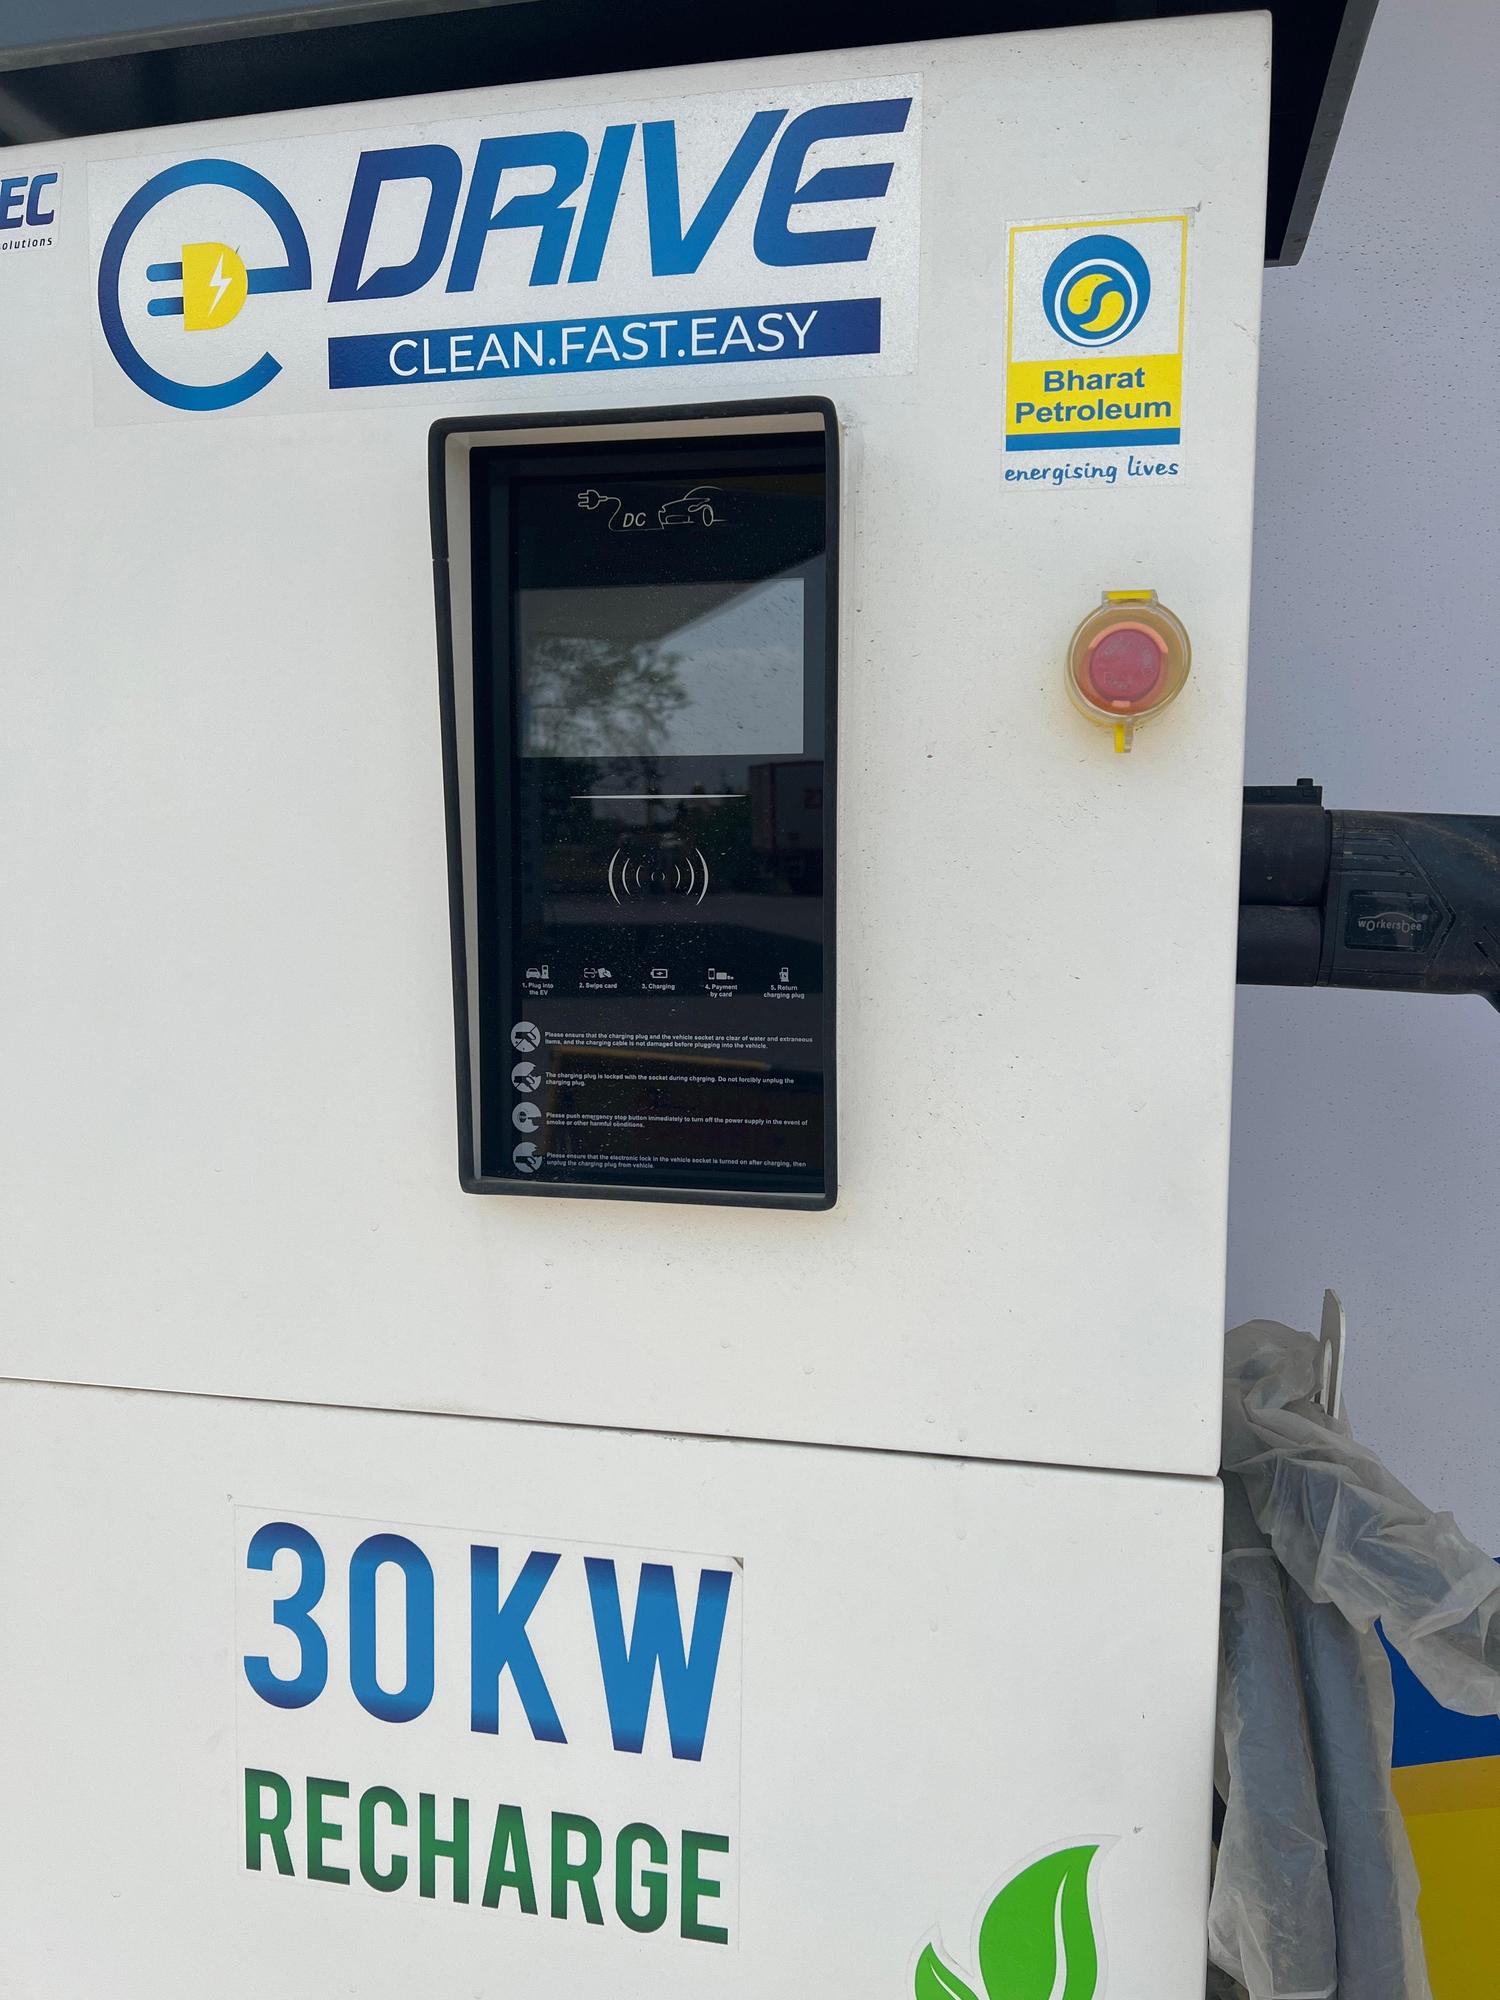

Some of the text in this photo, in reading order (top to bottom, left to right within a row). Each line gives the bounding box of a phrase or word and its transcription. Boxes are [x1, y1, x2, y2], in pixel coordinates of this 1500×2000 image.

[327, 97, 913, 303] DRIVE
[0, 237, 53, 251] olutions
[389, 310, 818, 377] CLEAN.FAST.EASY
[1044, 367, 1145, 392] Bharat
[1015, 399, 1171, 424] Petroleum
[1004, 456, 1179, 486] energising lives
[623, 513, 646, 528] DC
[244, 1767, 730, 1946] RECHARGE
